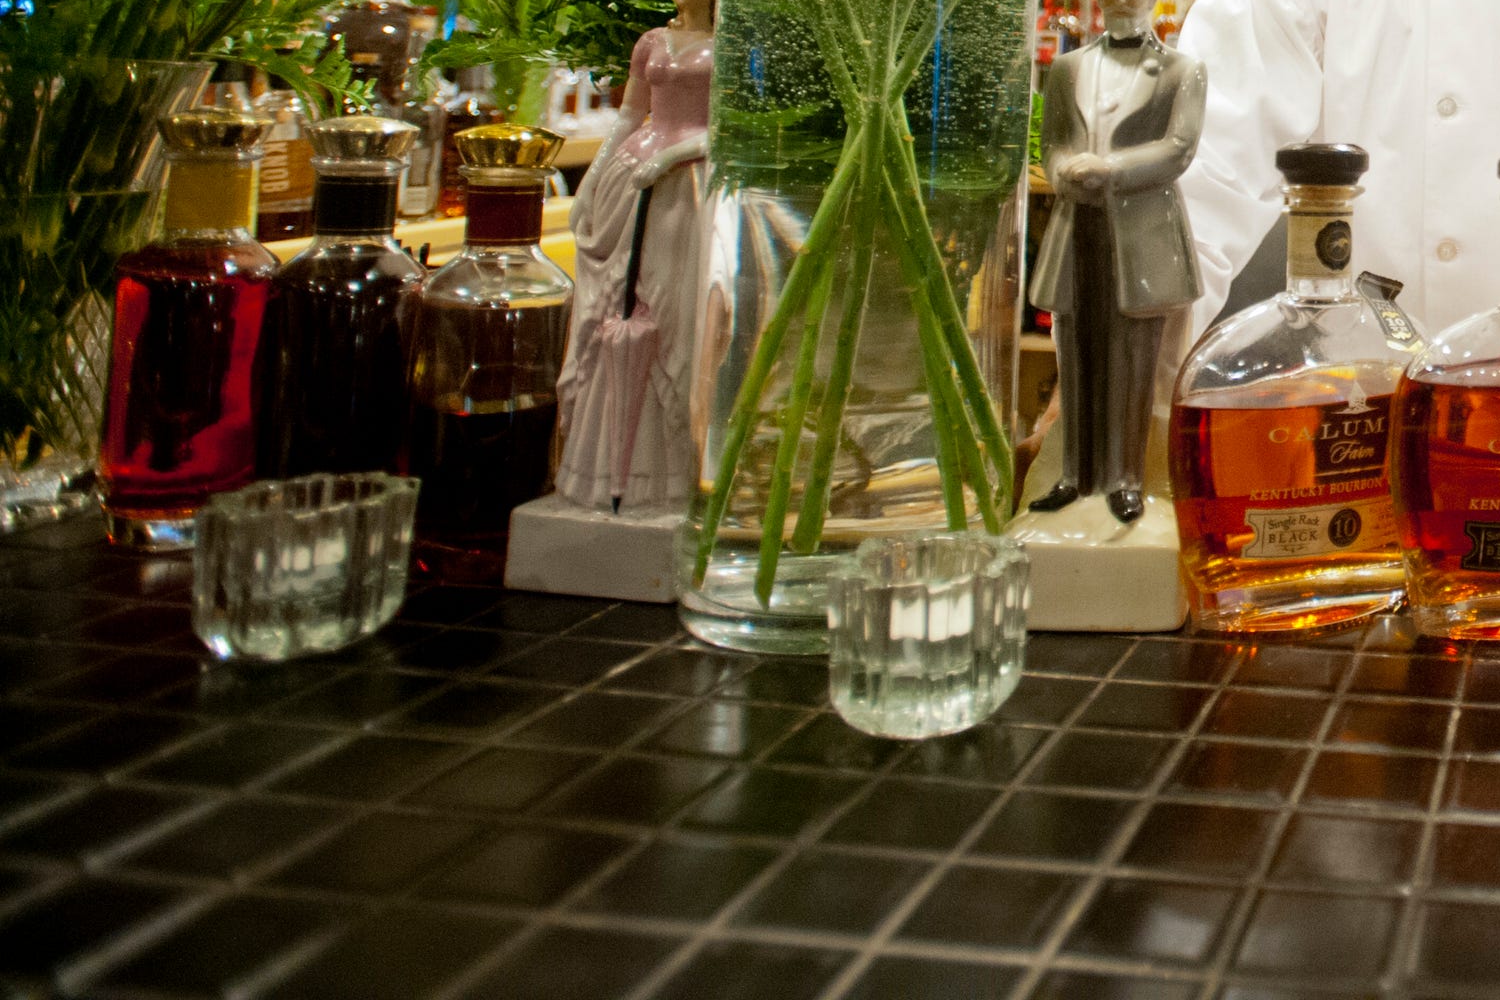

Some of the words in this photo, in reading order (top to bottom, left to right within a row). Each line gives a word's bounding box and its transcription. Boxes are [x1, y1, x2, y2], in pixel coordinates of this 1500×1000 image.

[1329, 440, 1375, 464] Farm
[1250, 484, 1326, 501] KENTUCKY
[1330, 478, 1383, 494] BOURBON
[1268, 530, 1319, 544] BLACK
[1335, 517, 1357, 539] 10
